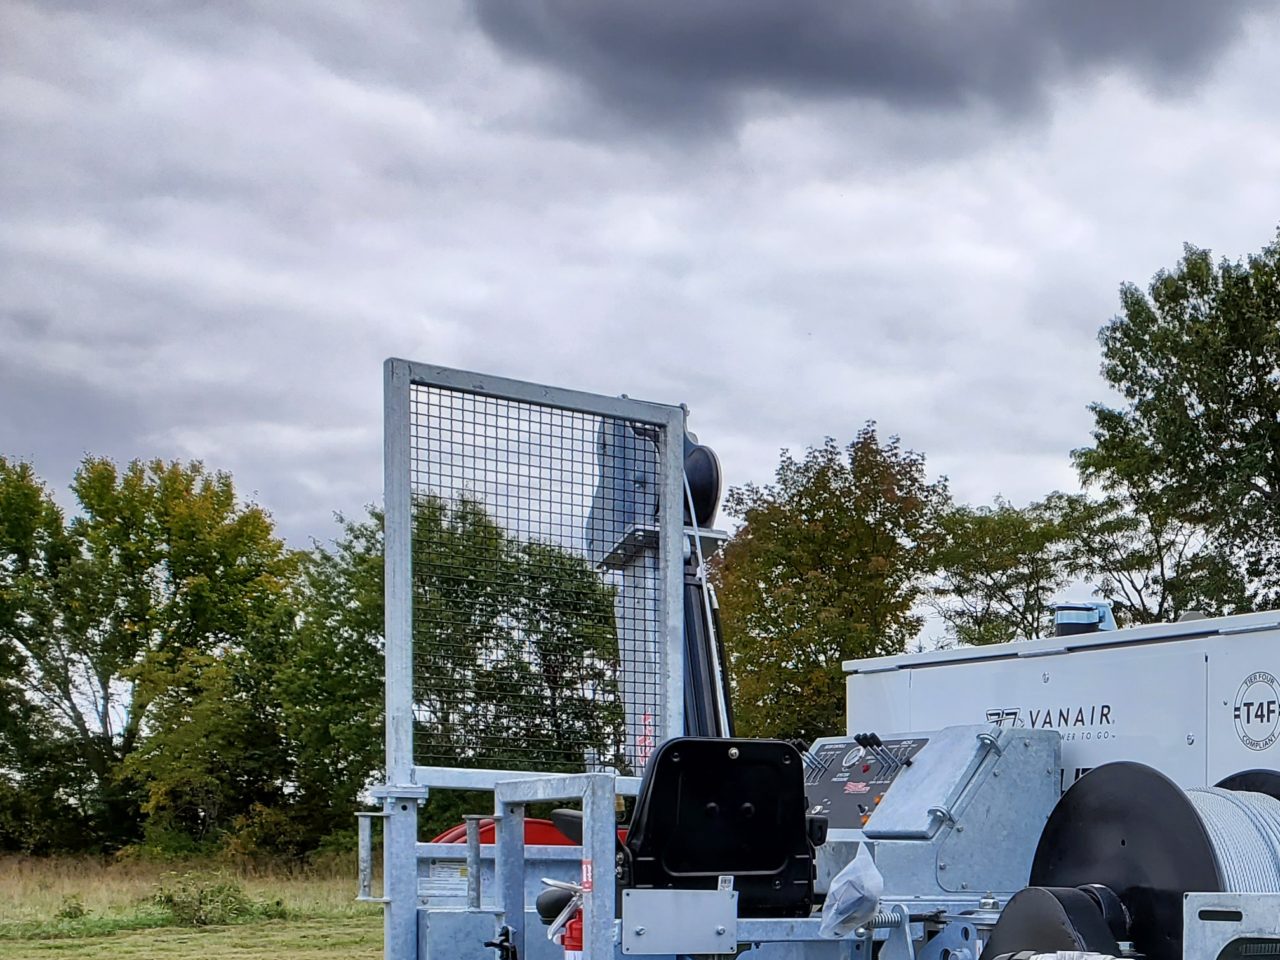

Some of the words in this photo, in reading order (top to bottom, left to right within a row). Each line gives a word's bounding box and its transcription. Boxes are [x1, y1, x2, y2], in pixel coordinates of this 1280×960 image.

[1244, 674, 1258, 687] TIER
[1258, 673, 1275, 686] FOUR
[1029, 704, 1112, 729] VANAIR
[1243, 700, 1276, 724] T4F
[1081, 732, 1092, 741] TO
[1097, 730, 1110, 740] GO
[1242, 732, 1277, 749] COMPLIANT
